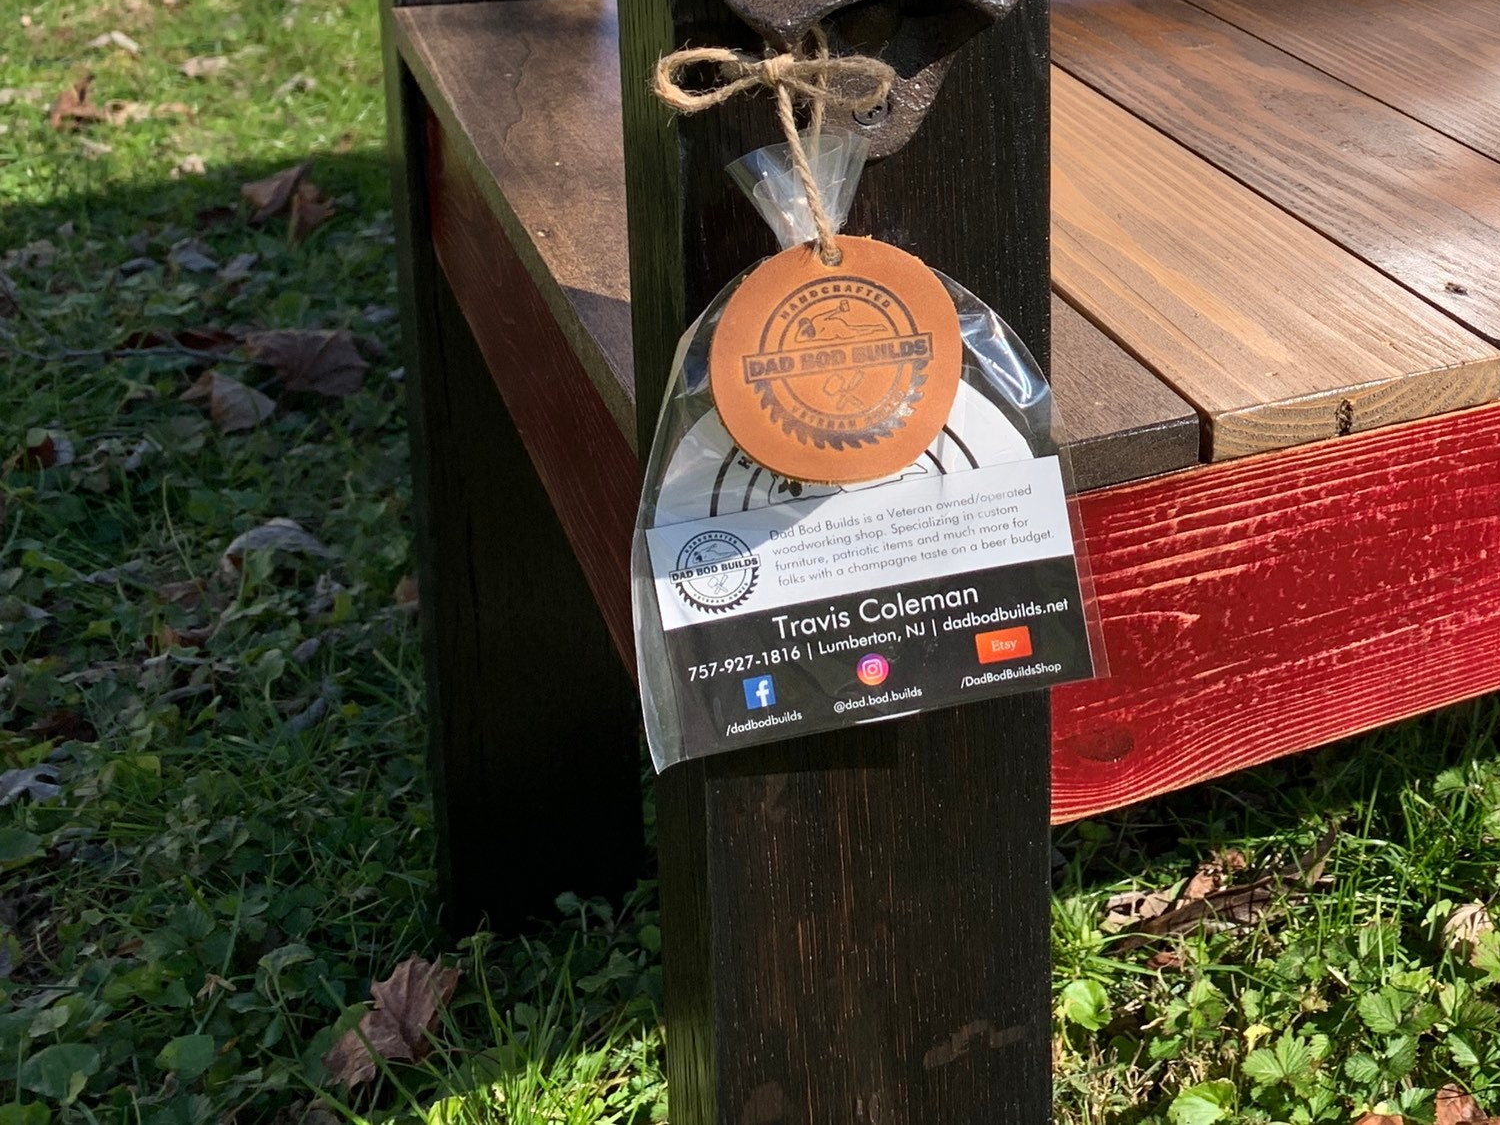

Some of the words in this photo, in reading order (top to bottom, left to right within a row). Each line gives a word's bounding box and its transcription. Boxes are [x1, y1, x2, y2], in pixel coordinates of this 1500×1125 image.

[780, 284, 892, 320] HANDCRAFTED
[749, 356, 795, 377] DAD
[800, 349, 847, 370] BOD
[852, 338, 929, 365] BUILDS
[769, 522, 795, 542] Dad
[798, 521, 822, 536] Bod
[825, 515, 860, 532] Builds
[863, 512, 873, 524] is
[876, 512, 885, 522] a
[886, 502, 933, 519] Veteran
[936, 484, 1033, 511] owned/operated
[772, 533, 852, 557] woodworking
[855, 526, 887, 545] shop.
[890, 512, 960, 535] Specializing
[963, 510, 974, 522] in
[977, 503, 1019, 519] custom
[775, 552, 829, 573] furniture,
[832, 543, 880, 564] patriotic
[882, 537, 914, 553] items
[917, 531, 940, 546] and
[943, 525, 976, 542] much
[979, 522, 1010, 536] more
[1012, 517, 1029, 530] for
[778, 569, 806, 588] folks
[809, 566, 833, 582] with
[836, 566, 845, 577] a
[848, 553, 918, 576] champagne
[920, 546, 948, 561] taste
[950, 543, 967, 555] on
[970, 542, 979, 552] a
[981, 535, 1007, 551] beer
[1011, 528, 1055, 549] budget.
[672, 569, 694, 582] DAD
[696, 565, 719, 577] BOD
[720, 557, 759, 573] BUILDS
[772, 605, 850, 640] Travis
[859, 586, 979, 623] Coleman
[688, 645, 801, 682] 757-927-1816
[818, 629, 902, 655] Lumberton,
[905, 621, 926, 639] NJ
[942, 598, 1069, 632] dadbodbuilds.net
[990, 638, 1017, 653] Etsy
[960, 661, 1062, 690] /DadBodBuildsShop
[833, 686, 924, 714] @dad.bod.builds
[726, 709, 803, 737] /dadbodbuilds
